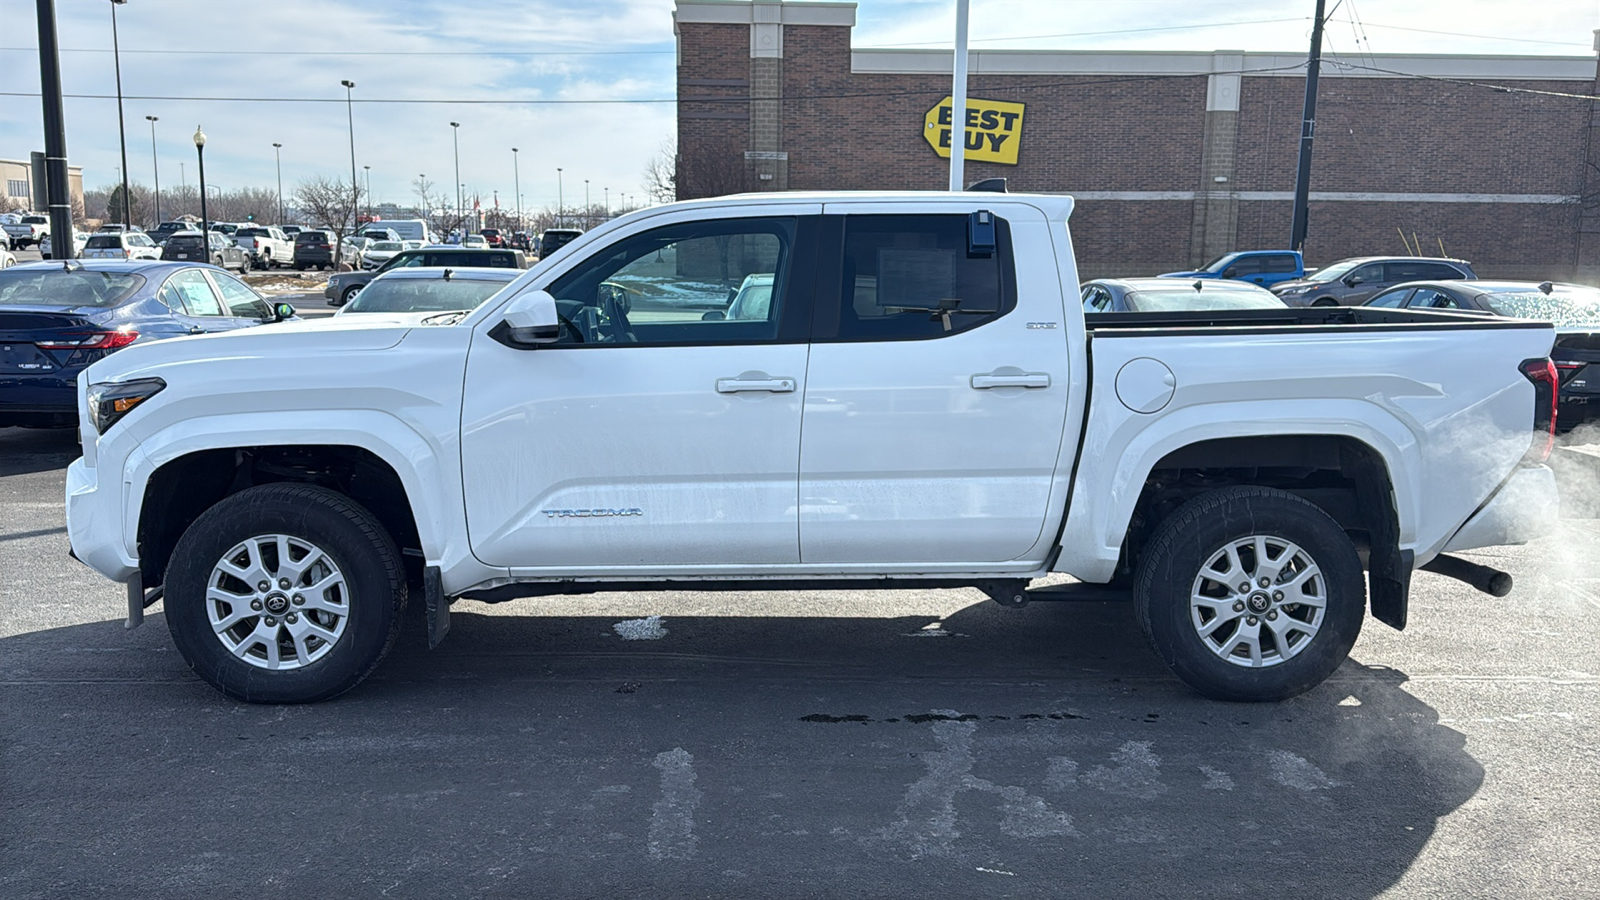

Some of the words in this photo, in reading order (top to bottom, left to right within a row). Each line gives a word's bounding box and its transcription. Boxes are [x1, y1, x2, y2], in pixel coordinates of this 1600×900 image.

[938, 106, 1020, 131] BEST
[939, 129, 1010, 153] BUY
[540, 507, 643, 518] TACOMA
